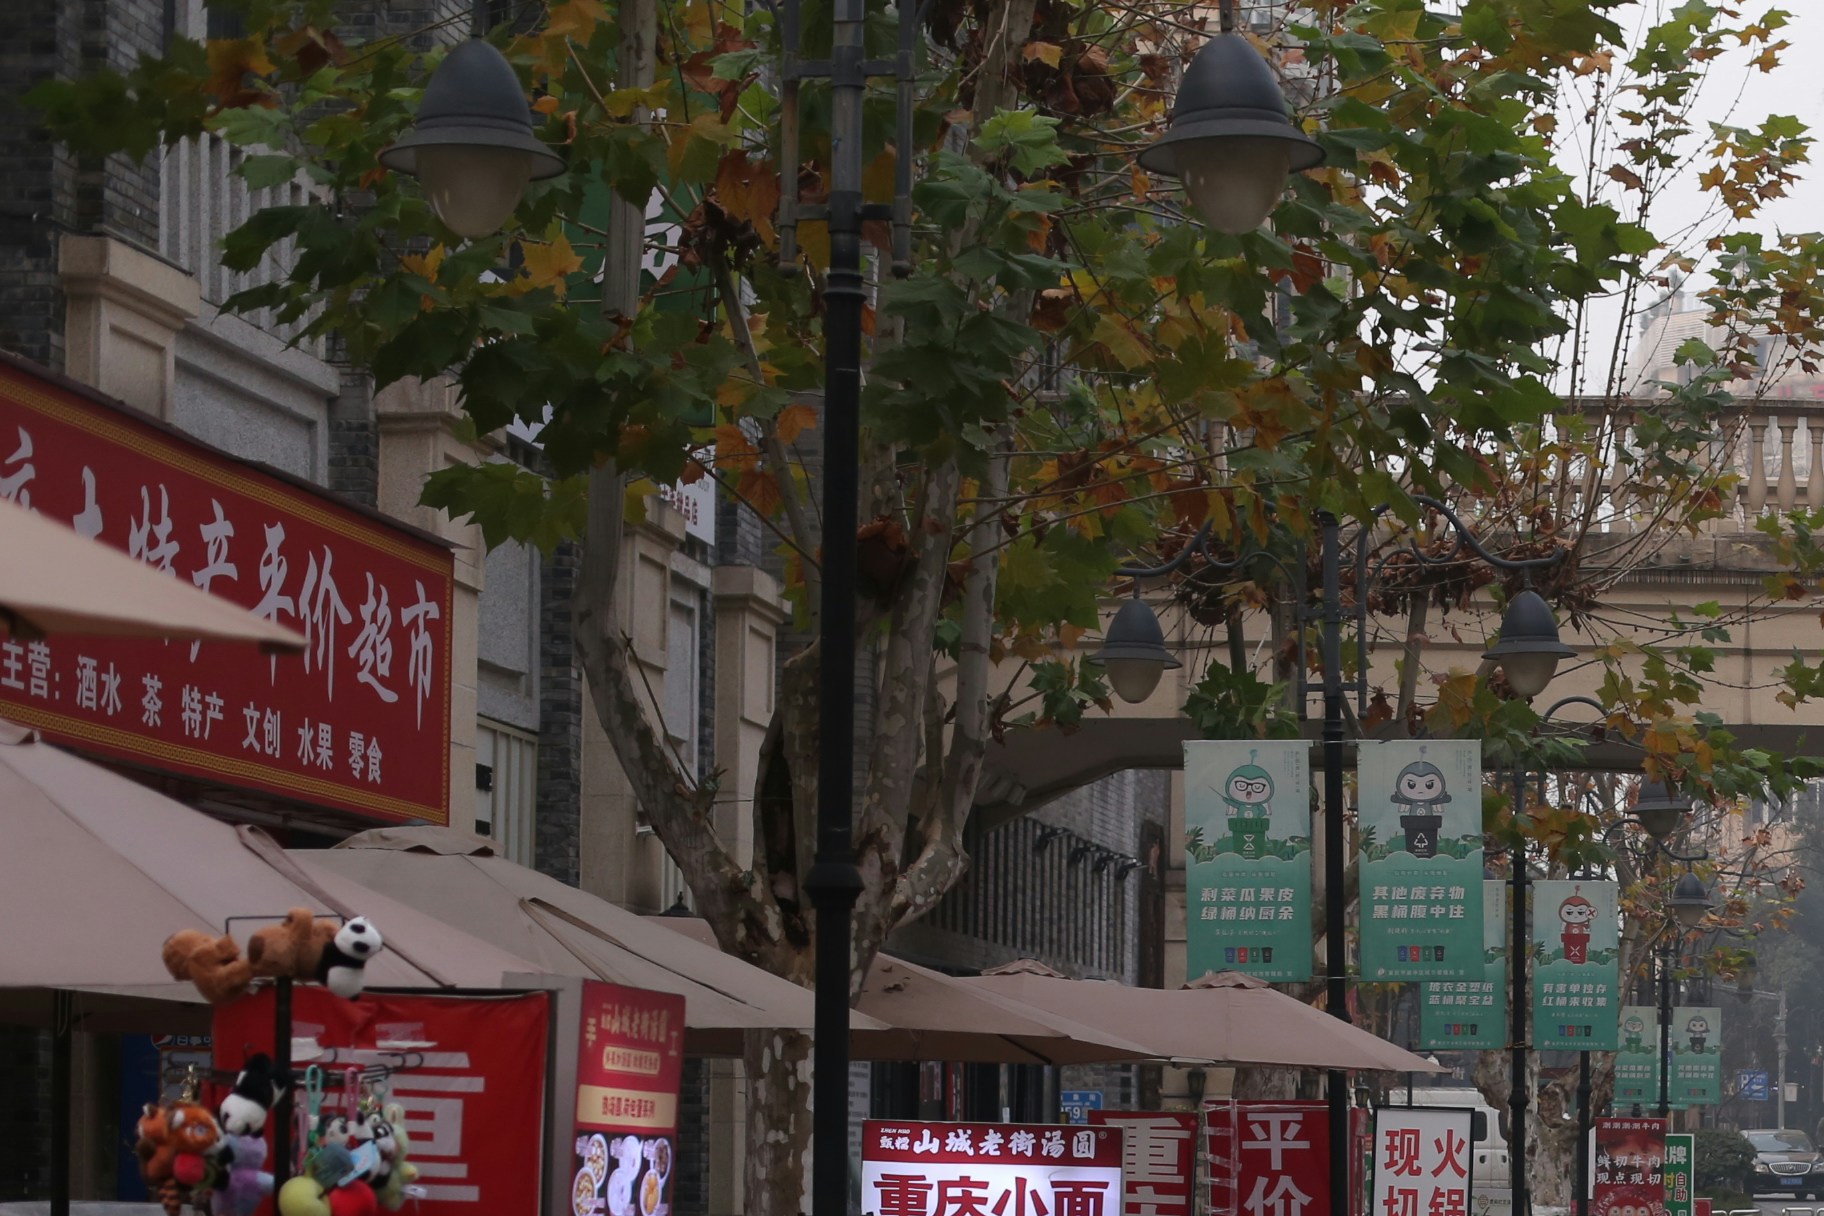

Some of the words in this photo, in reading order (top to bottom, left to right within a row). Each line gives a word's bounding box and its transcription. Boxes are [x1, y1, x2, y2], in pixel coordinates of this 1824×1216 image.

[76, 653, 122, 717] 酒水
[141, 672, 163, 728] 茶
[181, 684, 224, 740] 特产
[241, 701, 281, 759] 文创
[297, 717, 334, 770] 水果
[349, 730, 383, 785] 零食
[1201, 887, 1295, 902] 剩菜瓜果皮
[1372, 886, 1465, 900] 其他废弃物
[1201, 906, 1294, 920] 绿桶纳厨余
[1372, 904, 1465, 919] 黑桶腹中住
[1543, 983, 1608, 995] 有害单独存
[1541, 996, 1608, 1007] 红桶来收集
[1596, 1154, 1662, 1170] 鲜切牛肉
[1596, 1171, 1662, 1185] 现点现切
[1675, 1172, 1688, 1202] 自助
